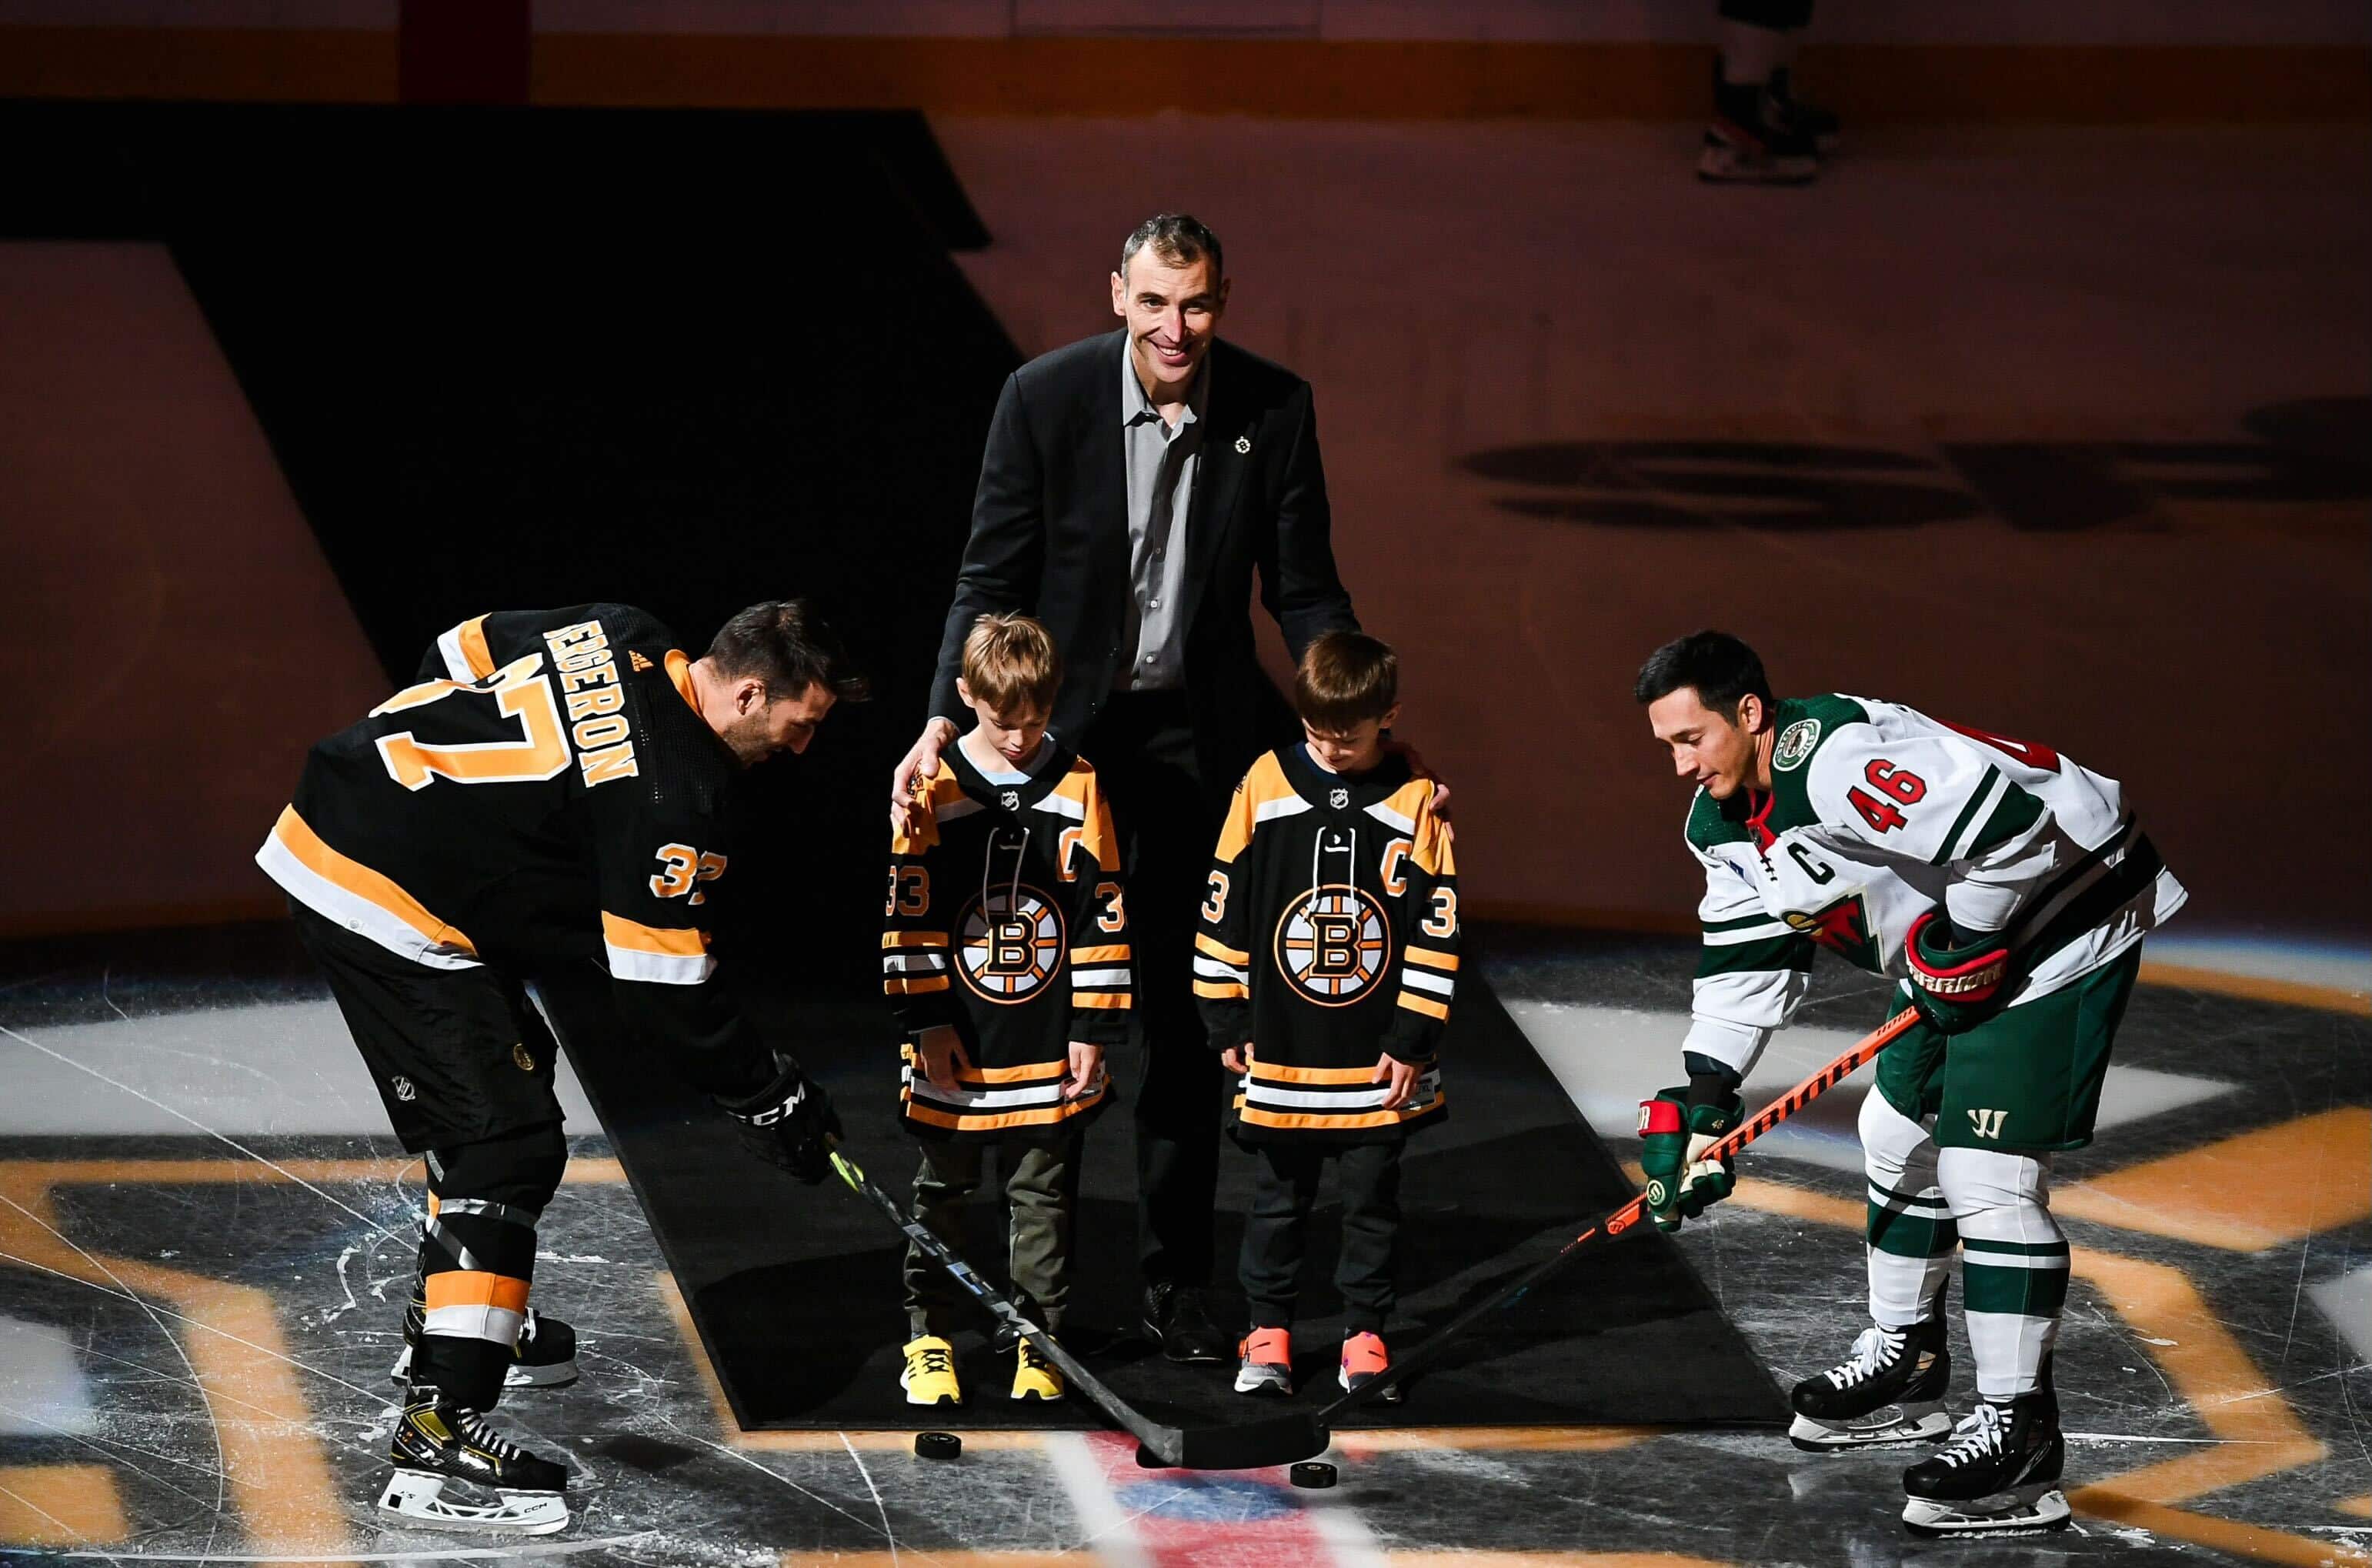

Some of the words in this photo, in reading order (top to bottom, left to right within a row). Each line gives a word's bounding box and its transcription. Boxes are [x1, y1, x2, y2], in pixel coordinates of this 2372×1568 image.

[542, 619, 639, 788] ERGERON
[1847, 758, 1927, 835] 46
[649, 842, 728, 906] 37
[1379, 837, 1414, 897] C
[1787, 842, 1836, 885] C
[984, 911, 1038, 976] B
[1307, 913, 1362, 978] B
[524, 1502, 548, 1513] CCM
